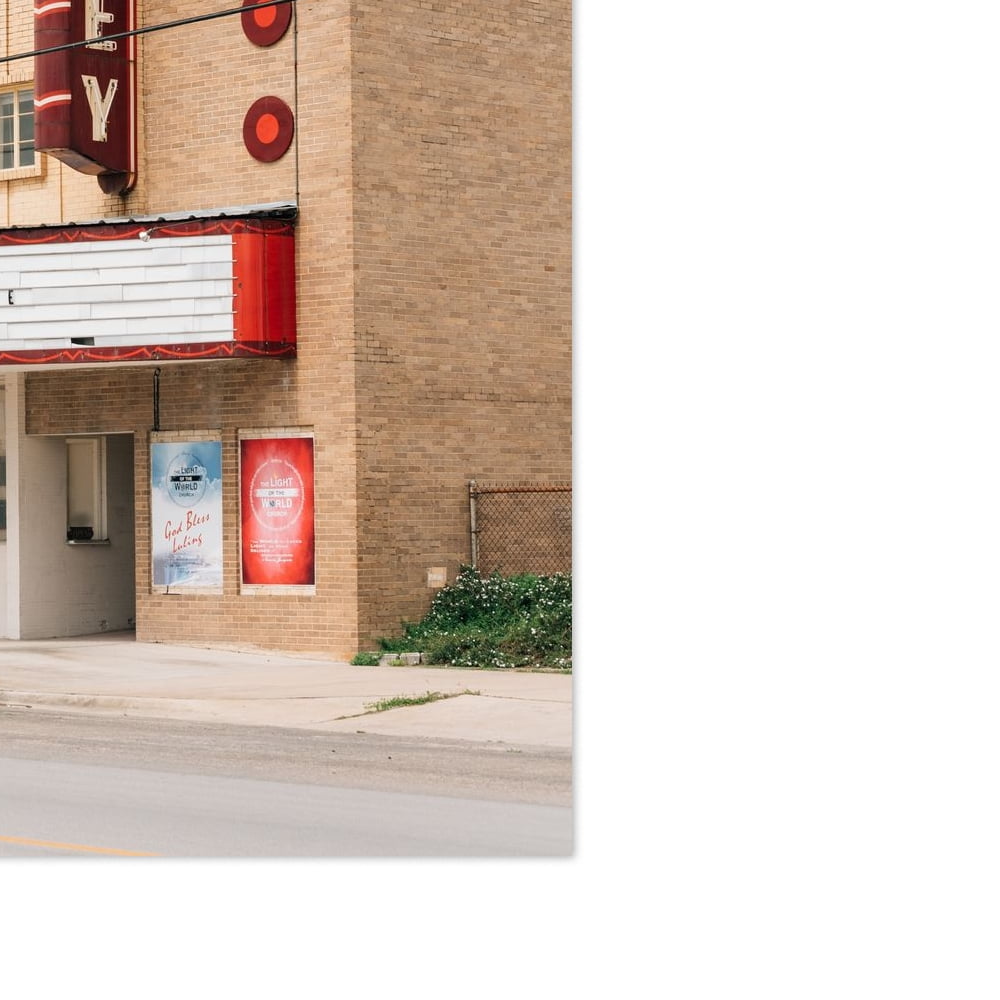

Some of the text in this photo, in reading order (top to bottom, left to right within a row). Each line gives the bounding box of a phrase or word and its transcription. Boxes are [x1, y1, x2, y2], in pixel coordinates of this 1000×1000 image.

[270, 477, 293, 487] LIGHT
[164, 510, 210, 542] God Bless
